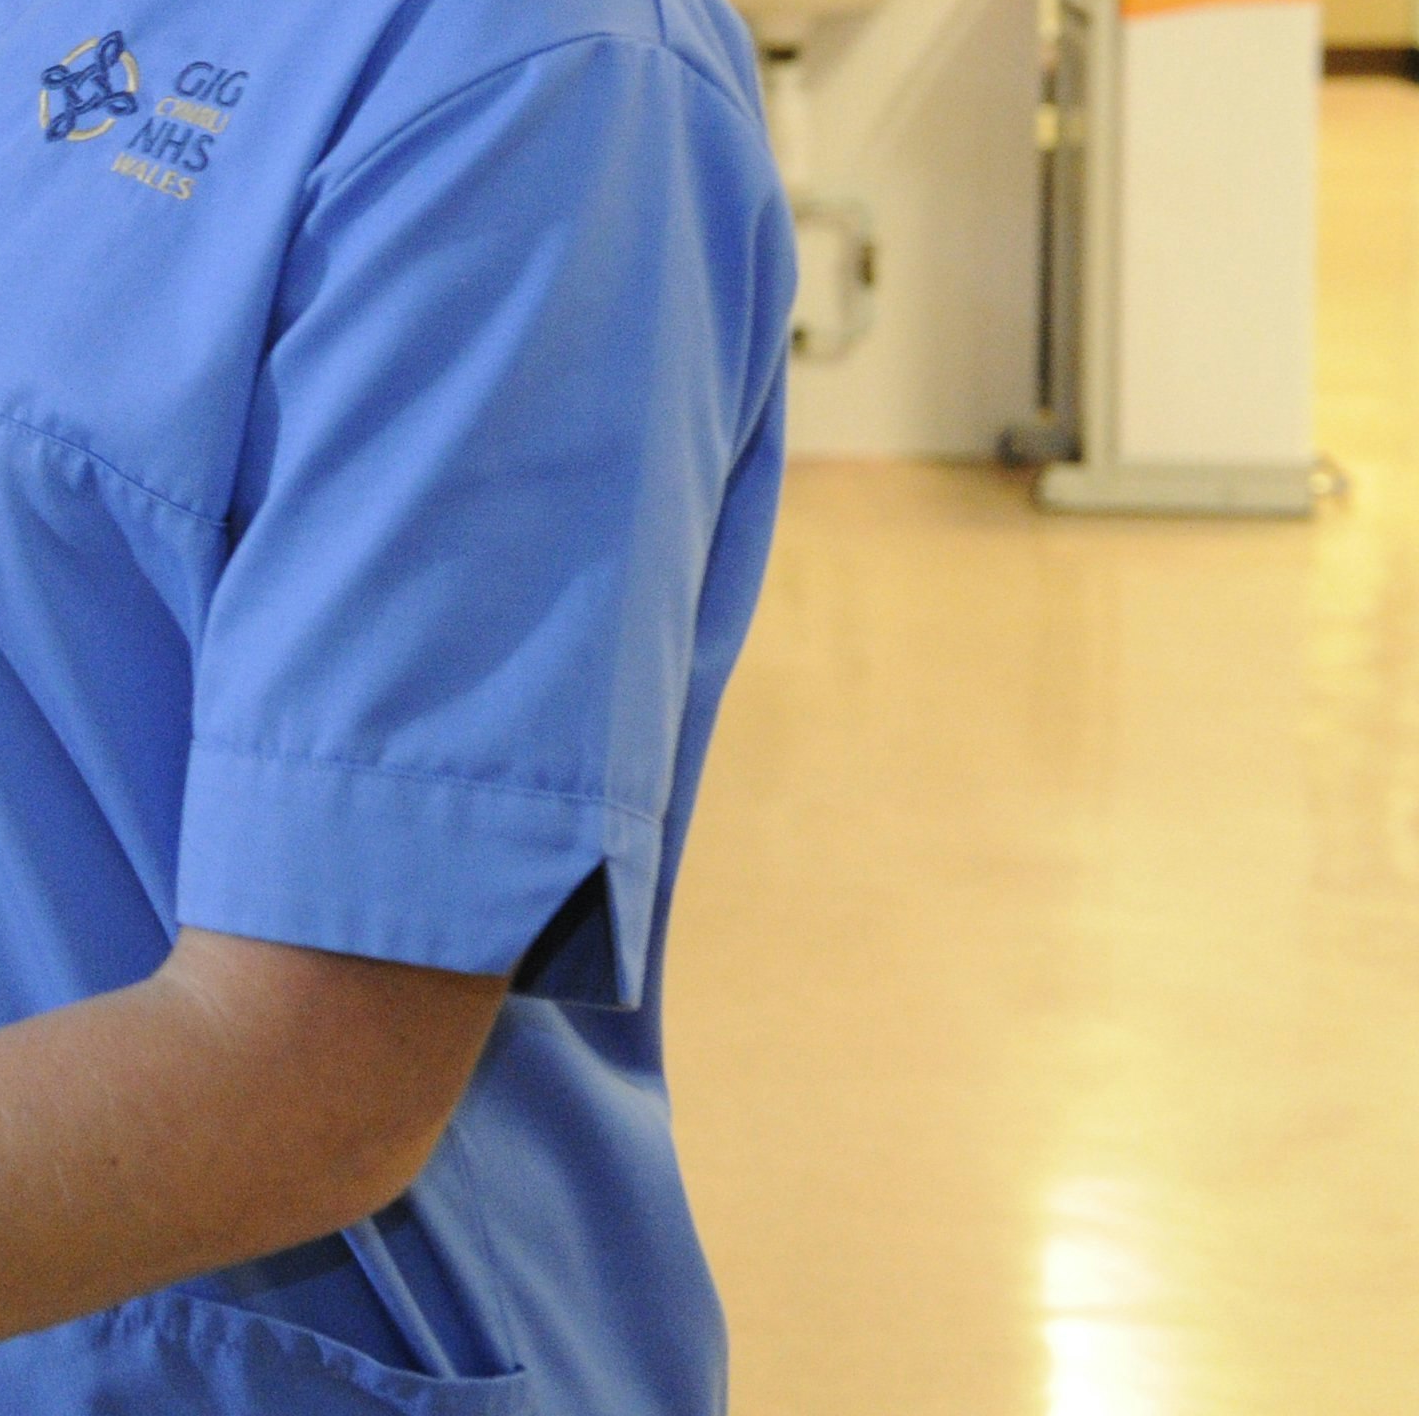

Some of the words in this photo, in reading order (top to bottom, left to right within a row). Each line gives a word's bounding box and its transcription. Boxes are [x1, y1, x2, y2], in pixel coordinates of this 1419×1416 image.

[175, 60, 249, 108] GIG
[126, 116, 215, 172] NHS
[111, 151, 196, 200] WALES
